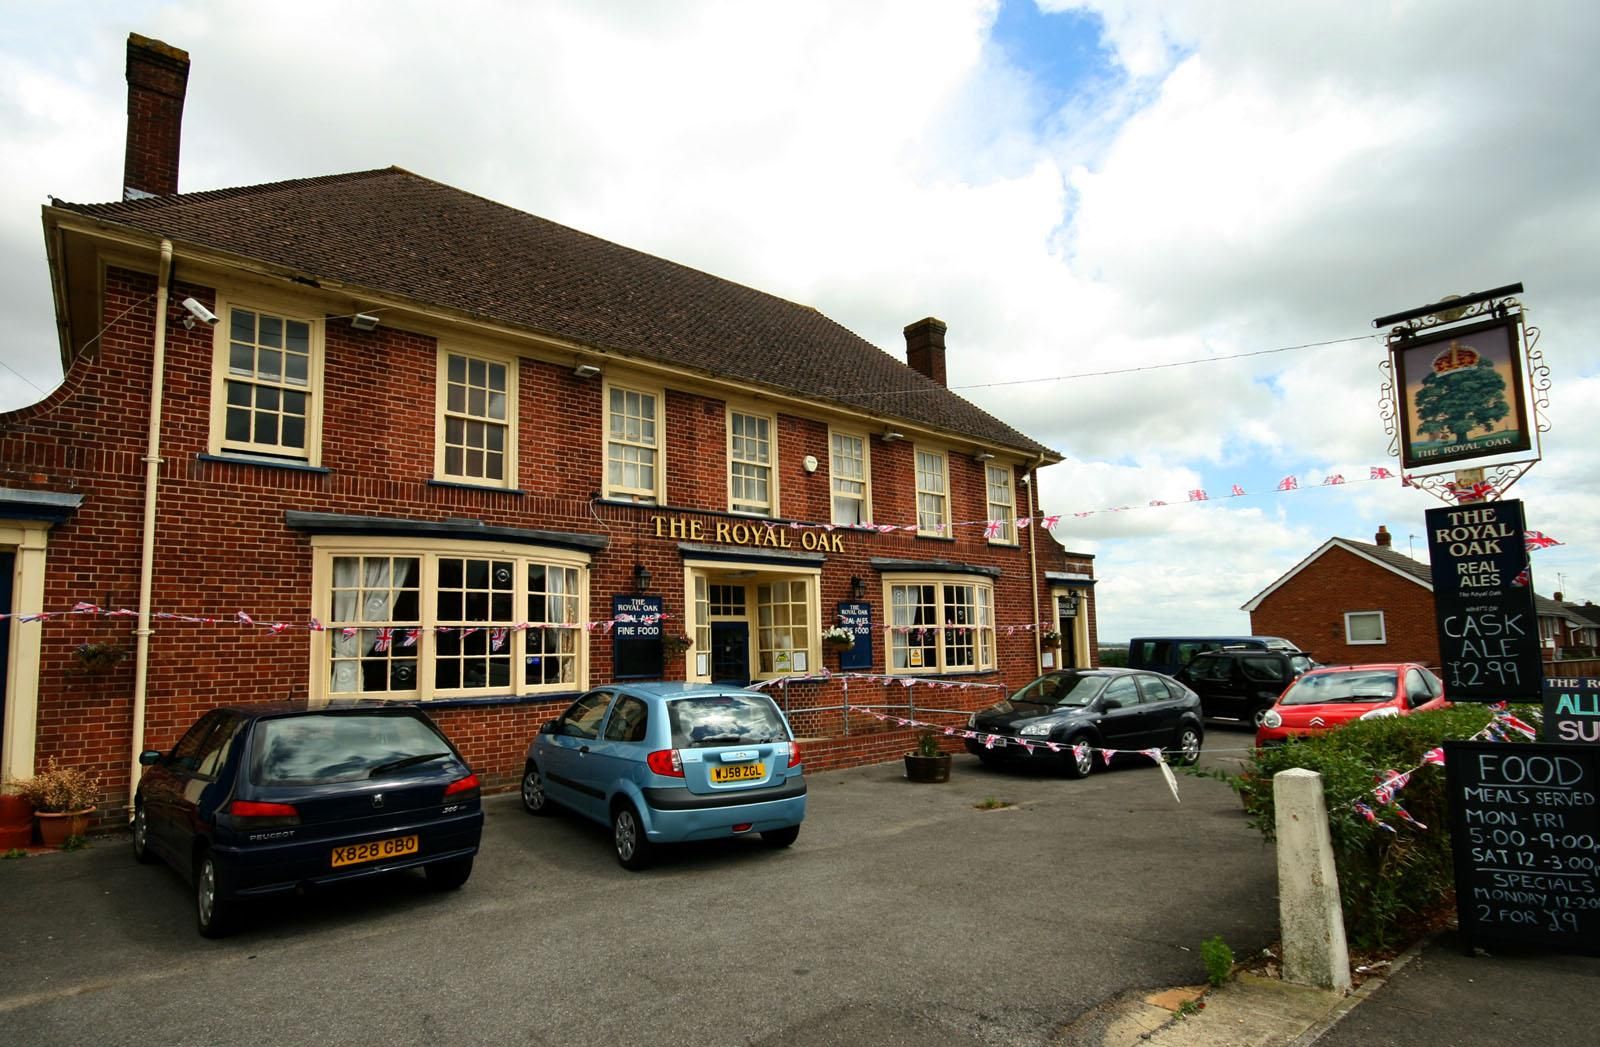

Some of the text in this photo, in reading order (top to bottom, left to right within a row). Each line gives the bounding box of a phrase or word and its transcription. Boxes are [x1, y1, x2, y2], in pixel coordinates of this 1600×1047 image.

[1417, 437, 1512, 458] THE ROYAL OAK
[1447, 508, 1497, 526] THE
[650, 515, 845, 553] THE ROYAL OAK
[1435, 523, 1515, 545] ROYAL
[1450, 539, 1503, 558] OAK
[1457, 560, 1500, 575] REAL
[1460, 573, 1501, 588] ALES
[617, 626, 660, 636] FINE FOOD
[1444, 613, 1526, 638] CASK
[1461, 638, 1520, 659] ALE
[1448, 660, 1521, 688] £2.99
[1546, 678, 1580, 688] THE
[715, 765, 762, 780] WJ58 ZGL
[1479, 754, 1584, 786] FOOD
[1464, 786, 1596, 807] MEALS SERVED
[1465, 809, 1518, 826] MON
[1532, 812, 1565, 829] FRI
[249, 830, 296, 842] PEUGEOT
[333, 836, 416, 864] X828 GBO
[1472, 847, 1508, 864] SAT
[1493, 873, 1595, 893] SPECIALS
[1474, 887, 1548, 907] MONDAY
[1477, 904, 1579, 933] 2 FOR £9
